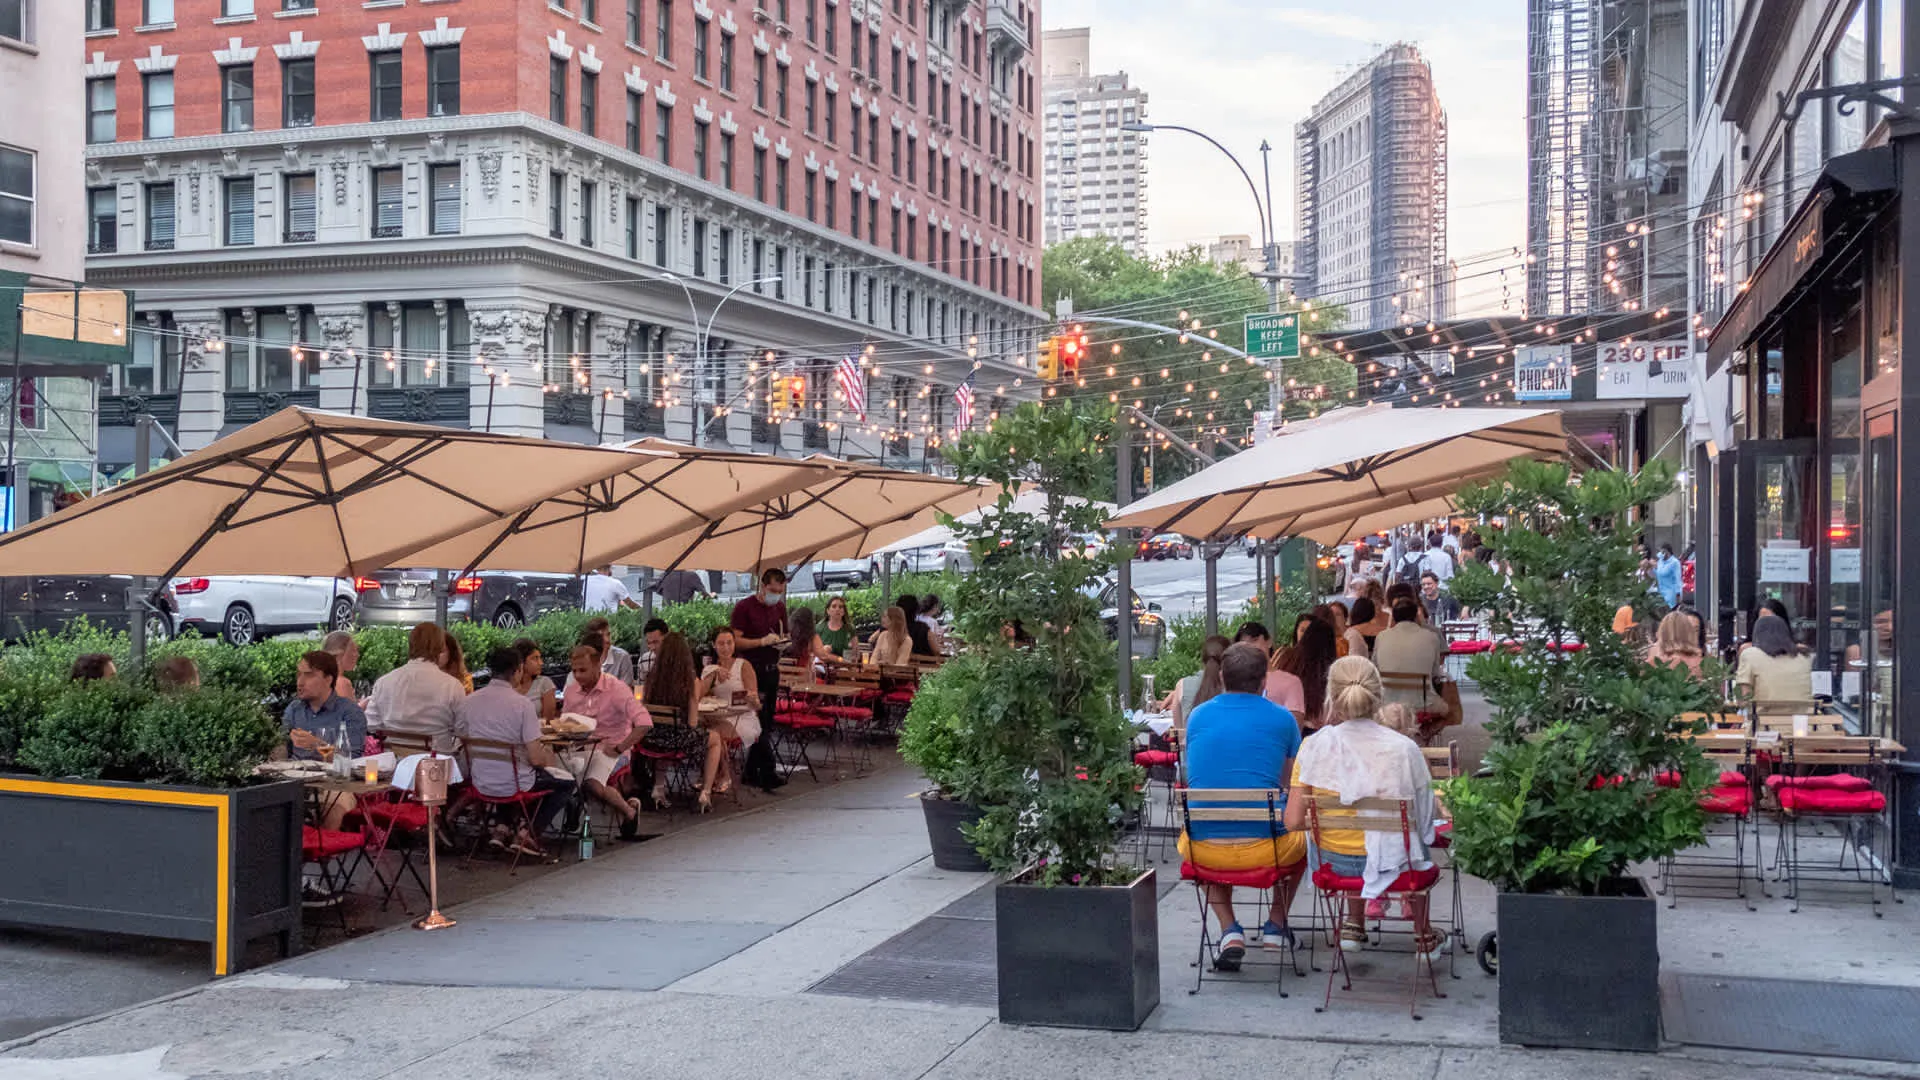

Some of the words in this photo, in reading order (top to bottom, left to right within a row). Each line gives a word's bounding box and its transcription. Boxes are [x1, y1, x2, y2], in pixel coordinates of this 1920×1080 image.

[1261, 330, 1283, 340] KEEP
[1261, 342, 1283, 353] LEFT
[1604, 346, 1645, 363] 230
[1519, 368, 1567, 391] PHOENIX
[1614, 371, 1630, 385] EAT
